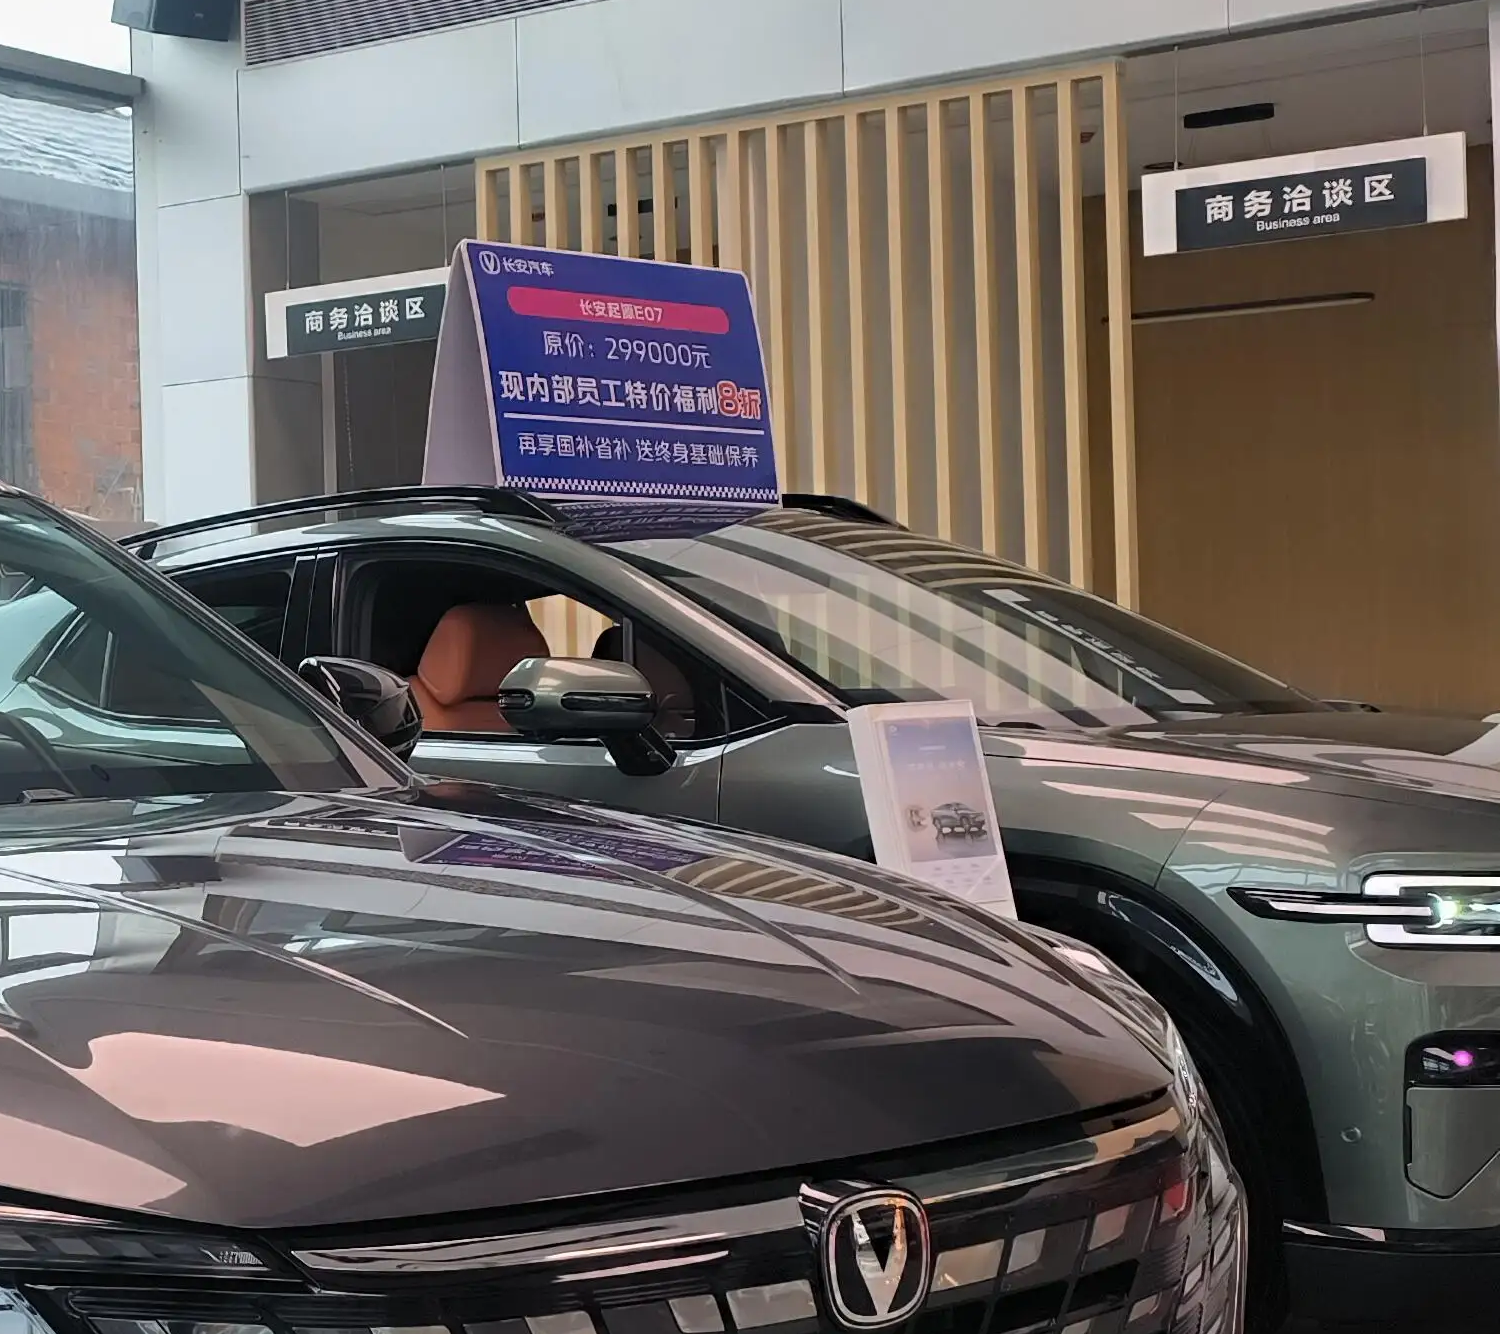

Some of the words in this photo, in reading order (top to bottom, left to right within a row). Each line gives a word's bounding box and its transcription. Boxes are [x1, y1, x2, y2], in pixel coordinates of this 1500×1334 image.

[1204, 173, 1395, 224] 商务洽谈区
[1256, 216, 1309, 231] Business
[1312, 213, 1340, 224] area
[502, 251, 554, 277] 长安汽车
[304, 296, 425, 334] 商务洽谈区
[580, 298, 663, 323] 长安起源E07
[337, 328, 373, 341] Business
[373, 326, 392, 336] area
[498, 370, 762, 420] 现内部员工特价福利8折
[517, 432, 632, 462] 再享国补省补
[635, 438, 759, 468] 送终身基础保养
